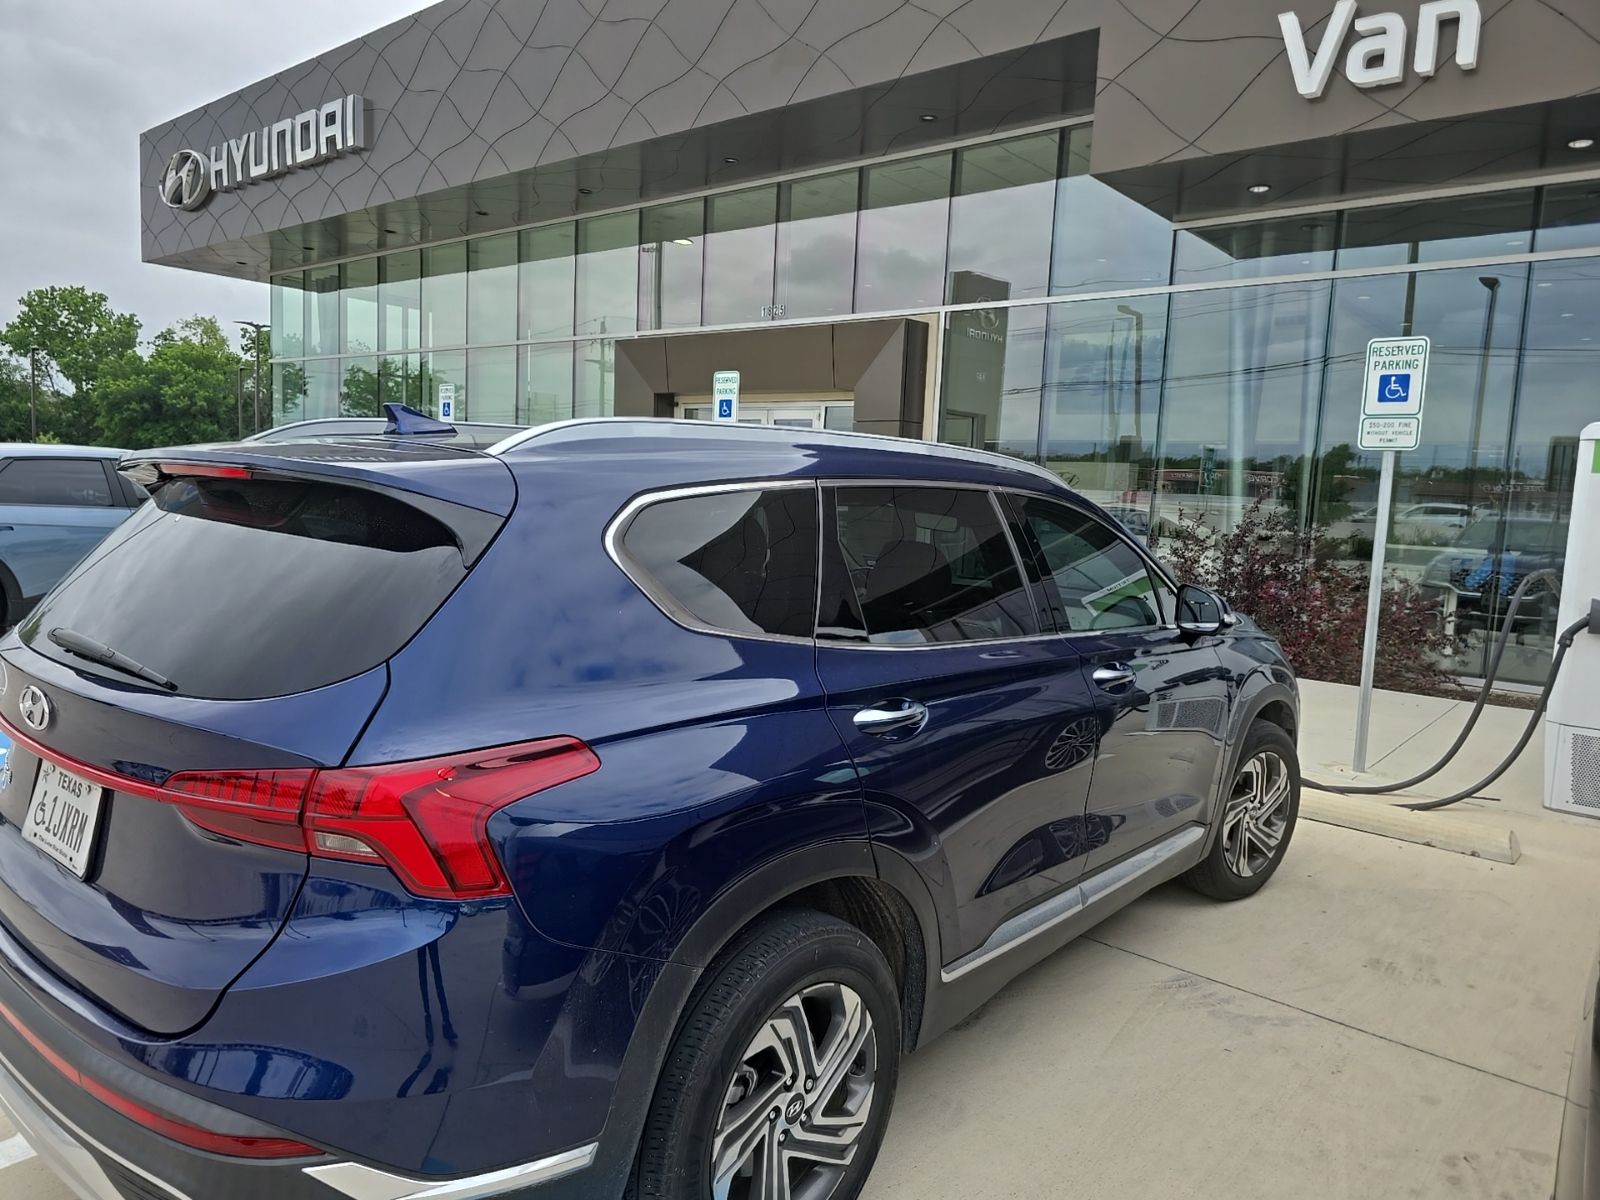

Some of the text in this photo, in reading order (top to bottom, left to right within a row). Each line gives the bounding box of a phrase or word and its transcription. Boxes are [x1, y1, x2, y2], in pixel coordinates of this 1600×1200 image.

[1278, 0, 1481, 98] Van
[211, 94, 364, 191] HYUNDAI
[1372, 344, 1424, 357] RESERVED
[1373, 359, 1419, 371] PARKING
[715, 376, 737, 384] RESERVED
[716, 387, 736, 395] PARKING
[57, 771, 83, 798] TEXAS
